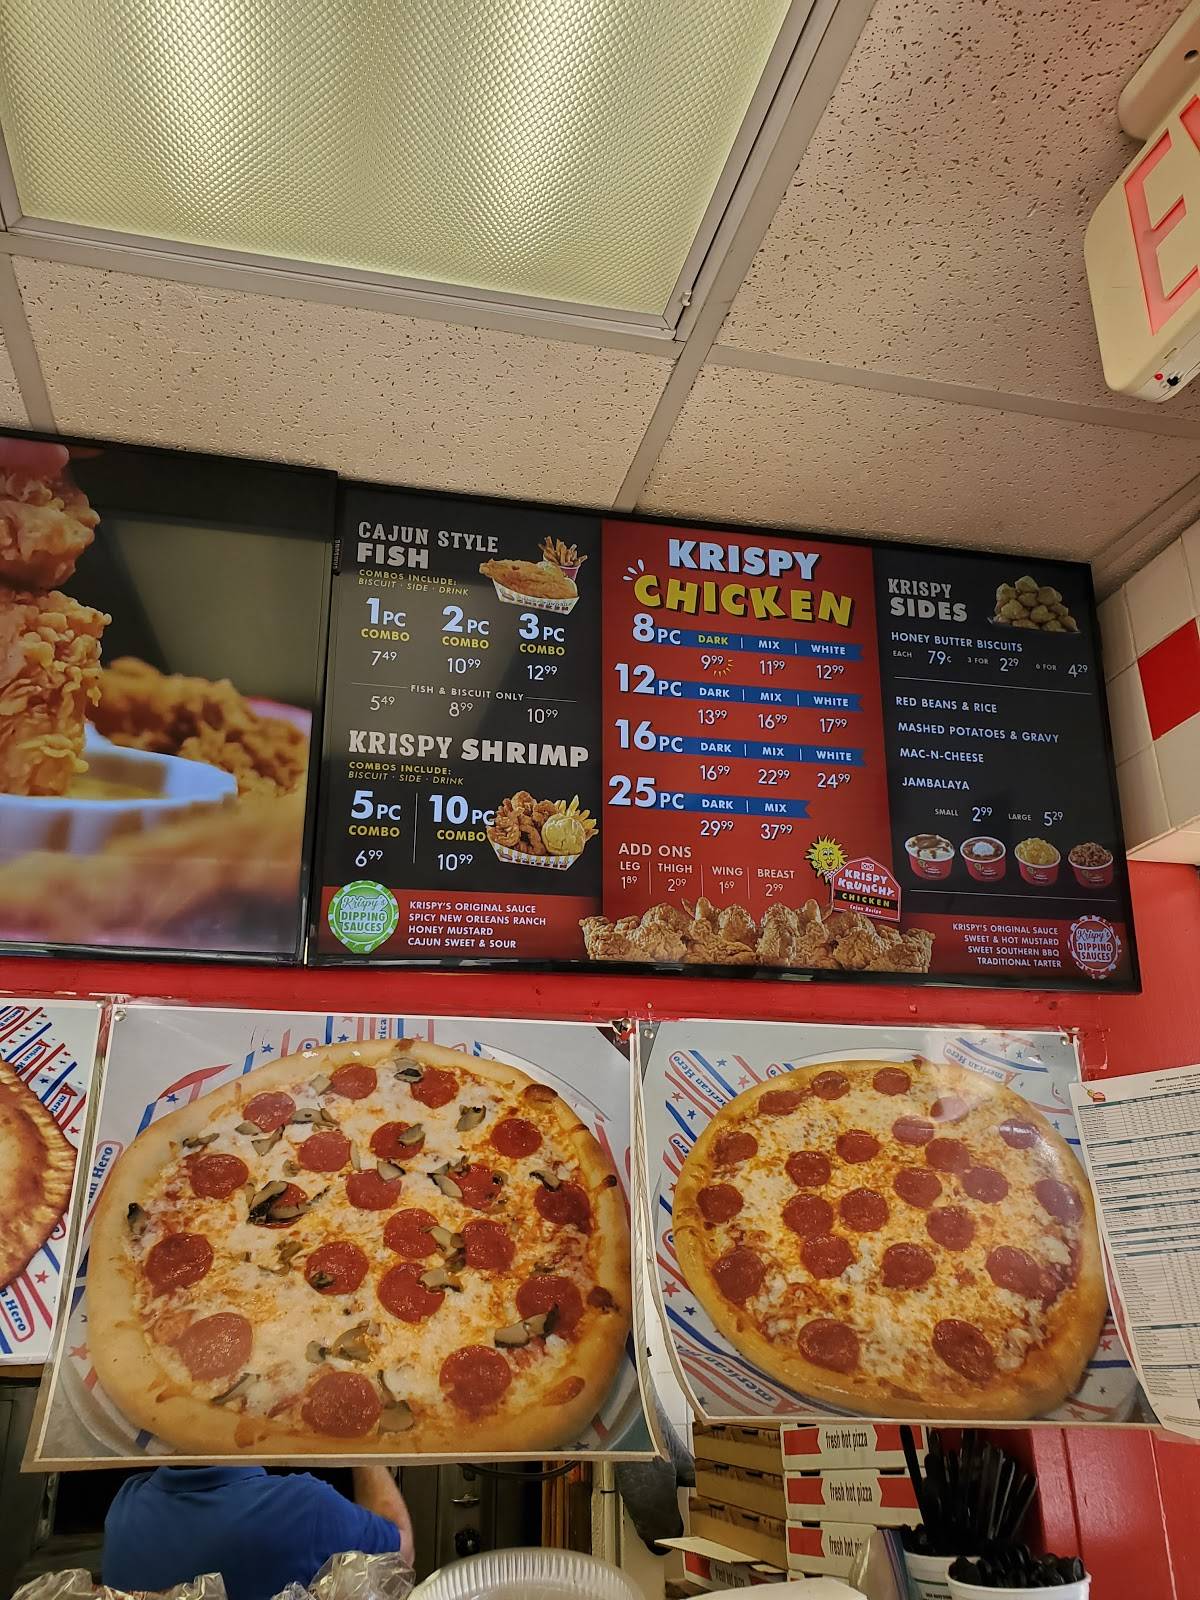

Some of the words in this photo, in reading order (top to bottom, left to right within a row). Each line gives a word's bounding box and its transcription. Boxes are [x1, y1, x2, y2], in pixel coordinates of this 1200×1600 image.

[358, 521, 429, 545] CAJUN
[437, 531, 498, 552] STYLE
[357, 543, 429, 569] FISH
[669, 538, 820, 580] KRISPY
[359, 569, 404, 580] COMBOS
[408, 574, 457, 586] INCLUDE:
[359, 578, 396, 589] BISCUIT
[407, 583, 428, 592] SIDE
[439, 587, 469, 596] DRINK
[888, 578, 952, 599] KRISPY
[634, 574, 852, 628] CHICKEN
[890, 597, 968, 622] SIDES
[361, 628, 410, 642] COMBO
[442, 636, 489, 649] COMBO
[519, 643, 565, 656] COMBO
[698, 634, 728, 645] DARK
[758, 640, 780, 650] MIX
[811, 644, 846, 655] WHITE
[891, 632, 930, 644] HONEY
[934, 635, 973, 648] BUTTER
[977, 640, 1023, 652] BISCUITS
[893, 650, 912, 658] EACH
[411, 684, 434, 694] FISH
[439, 687, 446, 695] &
[451, 688, 491, 699] BISCUIT
[496, 691, 524, 701] ONLY
[699, 688, 730, 698] DARK
[760, 692, 782, 702] MIX
[814, 696, 849, 707] WHITE
[896, 697, 917, 707] RED
[922, 699, 957, 710] BEANS
[962, 702, 969, 711] &
[974, 703, 997, 712] RICE
[898, 722, 945, 734] MASHED
[950, 726, 1005, 739] POTATOES
[1010, 731, 1017, 740] &
[1022, 731, 1059, 743] GRAVY
[349, 730, 452, 759] KRISPY
[461, 739, 589, 767] SHRIMP
[701, 743, 731, 753] DARK
[762, 747, 784, 757] MIX
[816, 750, 852, 761] WHITE
[900, 748, 984, 763] MAC-N-CHEESE
[349, 761, 397, 771] COMBOS
[401, 764, 451, 775] INCLUDE:
[348, 771, 388, 781] BISCUIT
[399, 774, 421, 783] SIDE
[433, 776, 464, 786] DRINK
[902, 777, 970, 791] JAMBALAYA
[702, 799, 733, 810] DARK
[764, 803, 787, 813] MIX
[935, 808, 958, 817] SMALL
[1008, 813, 1032, 821] LARGE
[349, 825, 400, 838] COMBO
[436, 829, 487, 842] COMBO
[618, 843, 651, 856] ADD
[658, 845, 692, 858] ONS
[620, 861, 640, 871] LEG
[658, 863, 692, 874] THIGH
[711, 866, 743, 877] WING
[757, 868, 795, 879] BREAST
[845, 869, 888, 884] KRISPY
[409, 901, 451, 911] KRISPY'S
[455, 902, 502, 913] ORIGINAL
[506, 904, 536, 914] SAUCE
[842, 893, 890, 907] CHICKEN
[341, 911, 387, 922] DIPPING
[409, 913, 436, 923] SPICY
[440, 914, 463, 924] NEW
[466, 915, 509, 925] ORLEANS
[513, 916, 546, 926] RANCH
[342, 922, 383, 932] SAUCES
[408, 925, 444, 935] HONEY
[447, 926, 493, 936] MUSTARD
[952, 923, 988, 932] KRISPY'S
[991, 924, 1030, 934] ORIGINAL
[1033, 926, 1058, 935] SAUCE
[408, 937, 441, 947] CAJUN
[444, 938, 476, 948] SWEET
[479, 939, 485, 948] &
[489, 939, 516, 949] SOUR
[964, 935, 989, 943] SWEET
[1001, 936, 1018, 944] HOT
[1021, 937, 1059, 946] MUSTARD
[1077, 942, 1112, 952] DIPPING
[968, 946, 993, 954] SWEET
[996, 947, 1039, 956] SOUTHERN
[1042, 948, 1059, 957] BBQ
[1081, 952, 1111, 961] SAUCES
[977, 957, 1031, 966] TRADITIONAL
[1034, 959, 1061, 968] TARTER
[94, 1146, 113, 1185] Hero
[6, 1299, 27, 1332] Hero
[825, 1432, 842, 1448] fresh
[843, 1432, 852, 1448] hot
[852, 1431, 868, 1451] pizza
[829, 1482, 844, 1502] fresh
[845, 1483, 855, 1502] hot
[856, 1482, 872, 1507] pizza
[829, 1533, 844, 1555] fresh
[844, 1535, 854, 1557] hot
